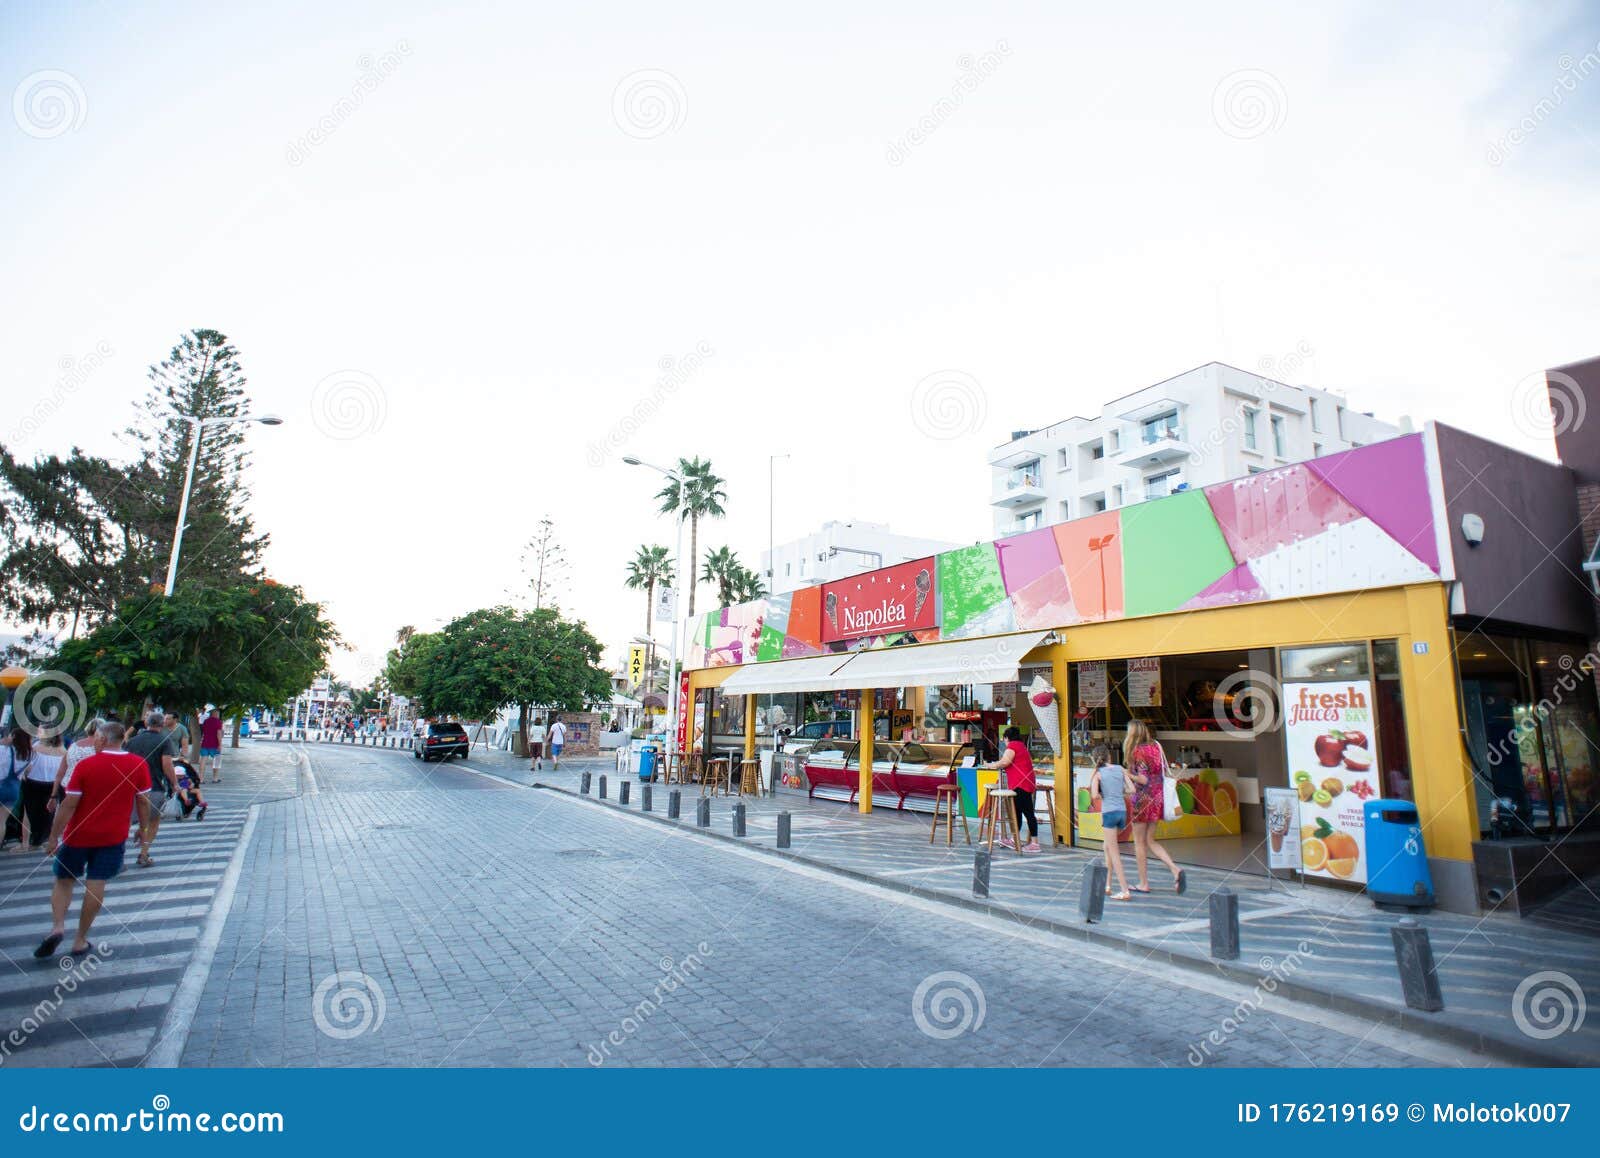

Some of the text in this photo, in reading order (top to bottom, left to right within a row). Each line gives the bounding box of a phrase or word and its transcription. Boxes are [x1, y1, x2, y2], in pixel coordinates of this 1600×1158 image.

[843, 597, 906, 632] Napoléa
[632, 649, 641, 683] TAXI
[1298, 687, 1366, 708] fresh
[1288, 704, 1340, 726] Juices
